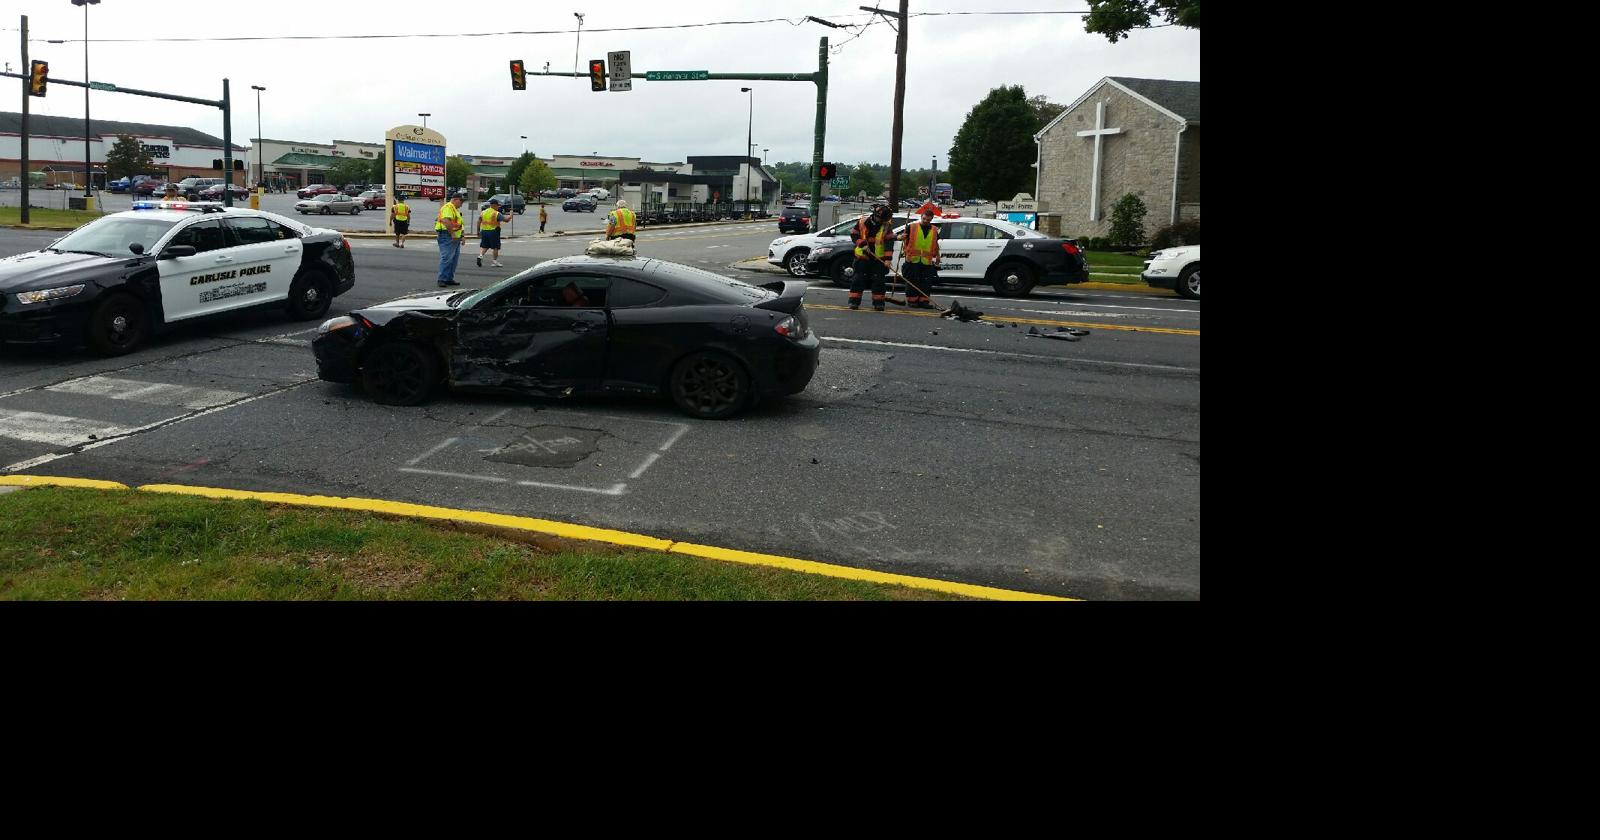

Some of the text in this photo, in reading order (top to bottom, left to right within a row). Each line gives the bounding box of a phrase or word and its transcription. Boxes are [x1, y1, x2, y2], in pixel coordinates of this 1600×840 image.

[397, 144, 431, 159] Walmart
[190, 264, 271, 285] CARLISLE POLICE
